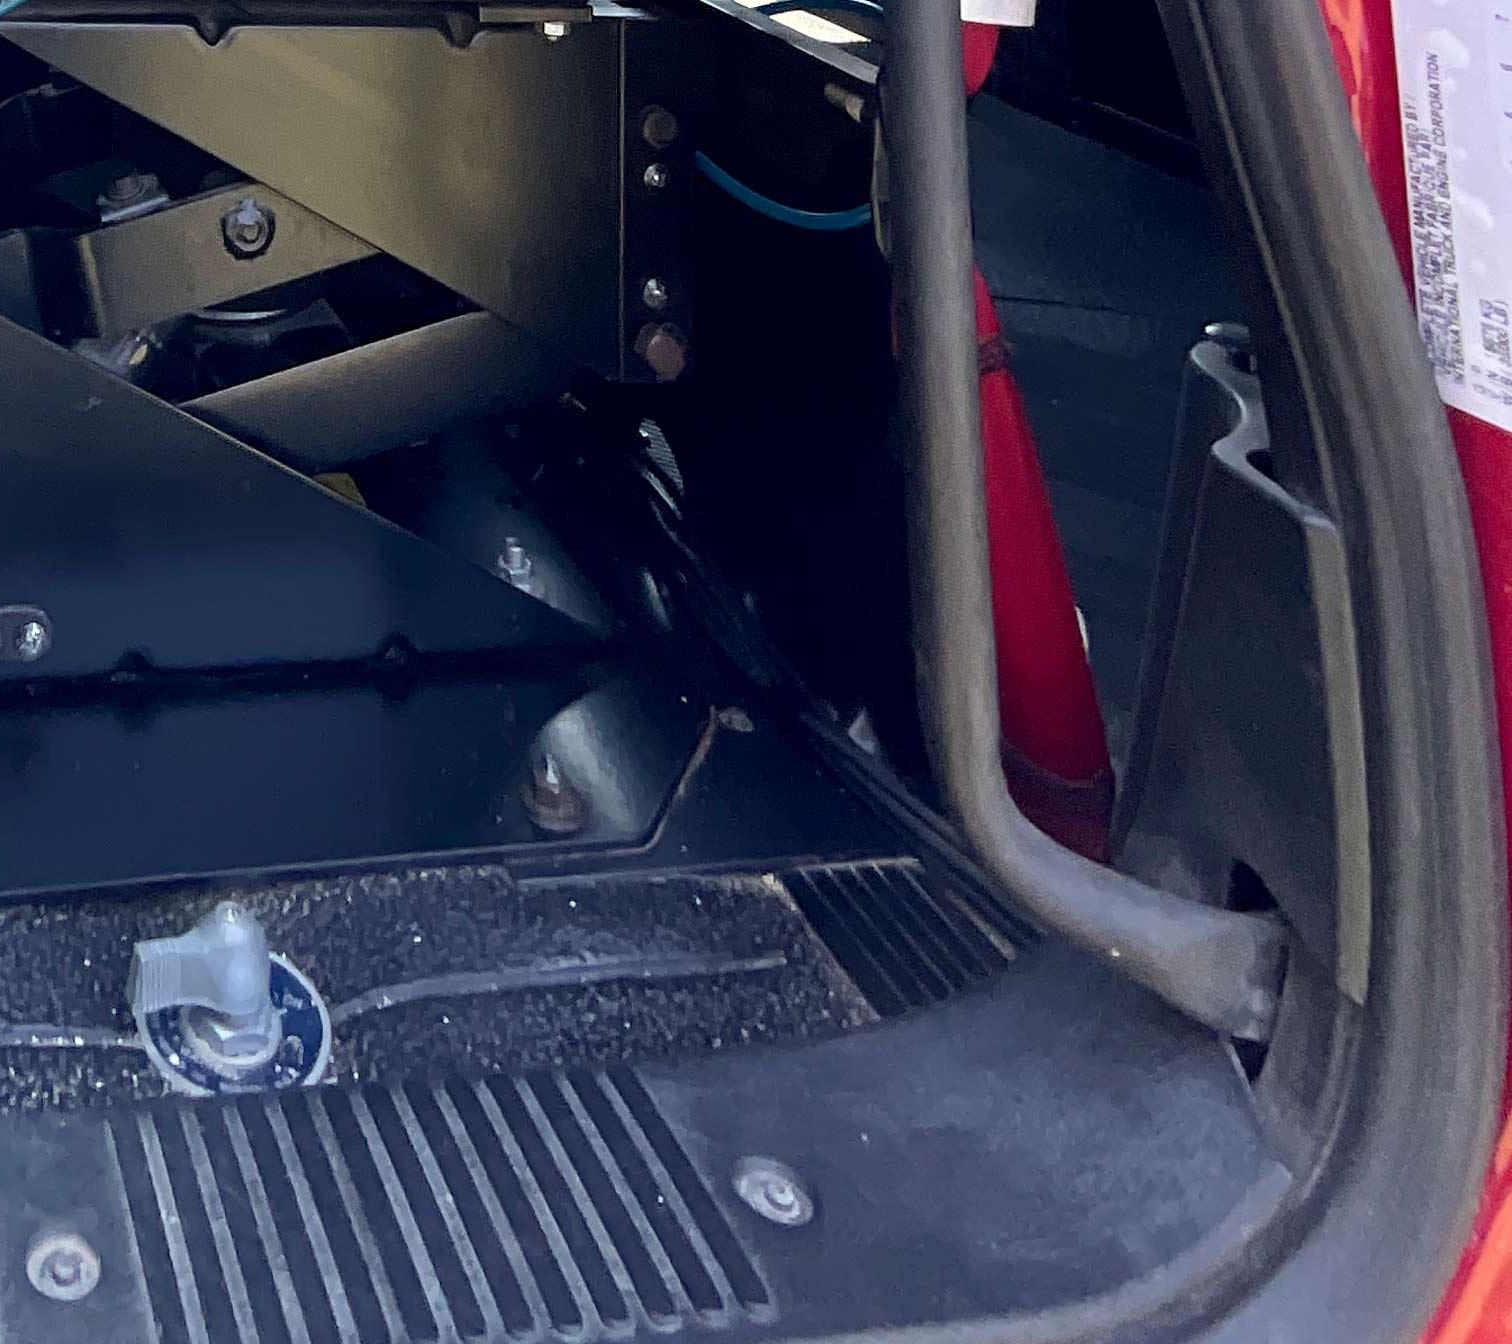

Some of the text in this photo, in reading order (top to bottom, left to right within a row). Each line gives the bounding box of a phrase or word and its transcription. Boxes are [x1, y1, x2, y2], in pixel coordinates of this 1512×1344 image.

[1426, 52, 1446, 146] CORPORATION
[1432, 151, 1449, 200] ENGINE
[1440, 204, 1451, 229] AND
[1442, 234, 1456, 275] TRUCK
